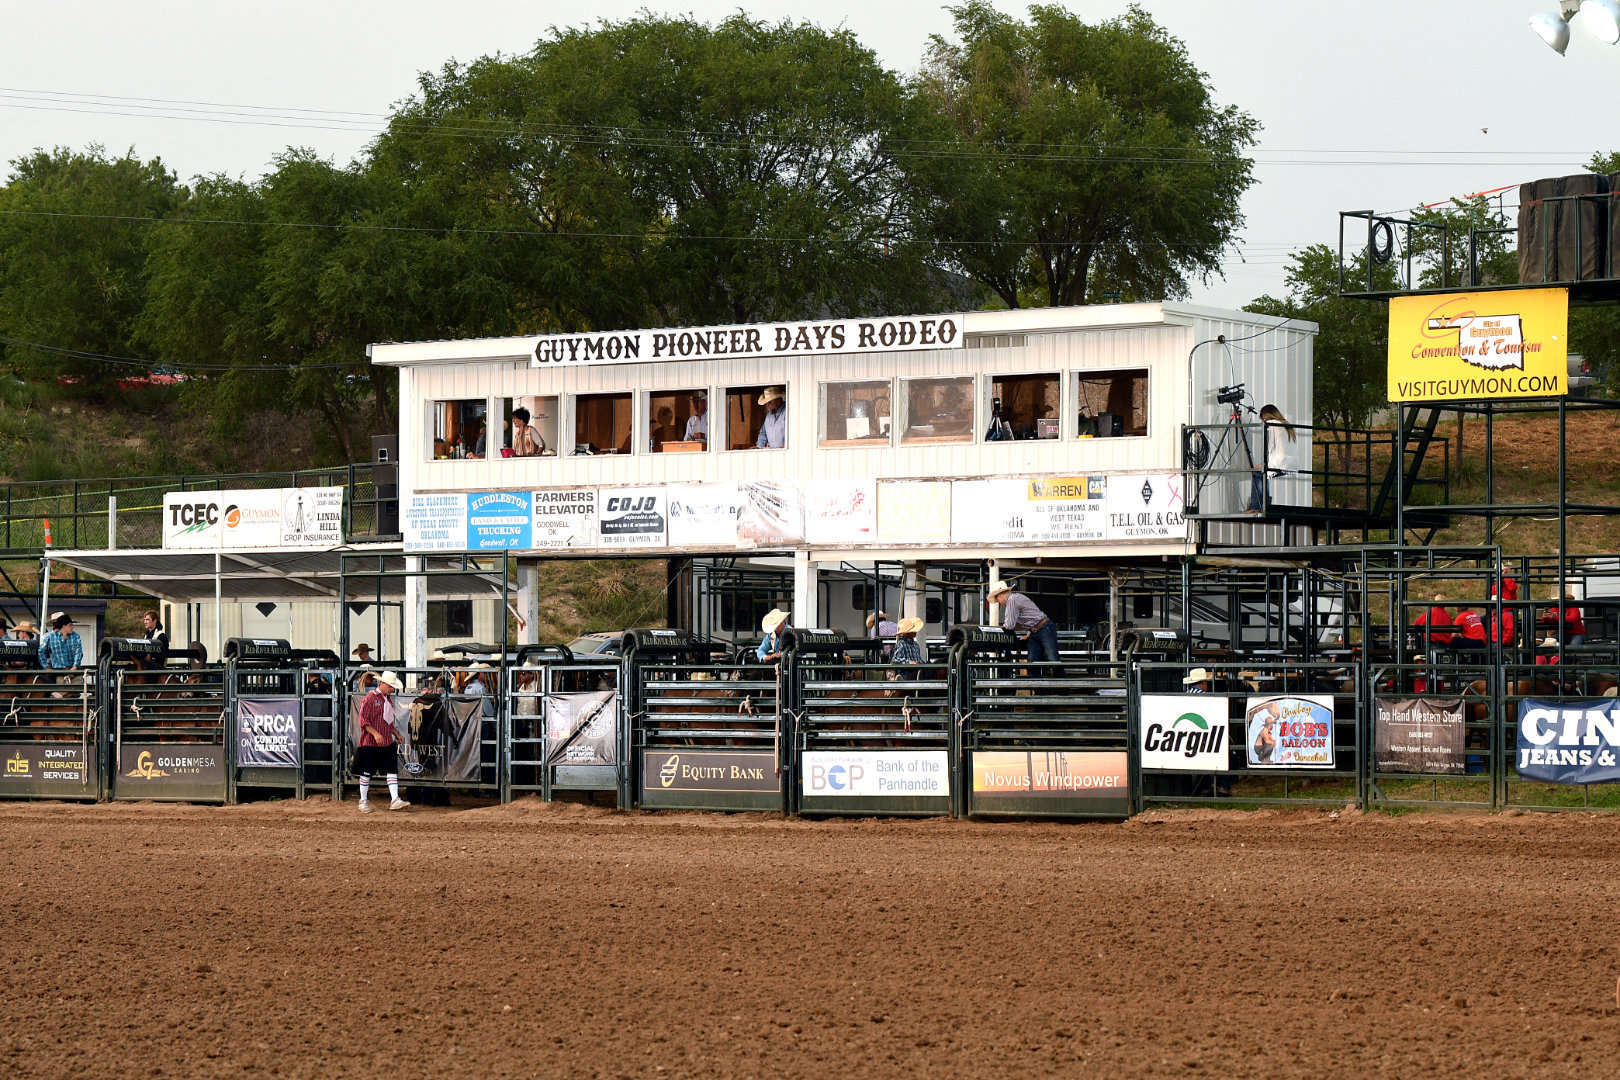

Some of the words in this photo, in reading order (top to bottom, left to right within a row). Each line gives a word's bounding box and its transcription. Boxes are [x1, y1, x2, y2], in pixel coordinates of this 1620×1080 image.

[1470, 326, 1512, 338] Guymon
[535, 334, 640, 363] GUYMON
[652, 328, 762, 357] PIONEER
[774, 324, 846, 351] DAYS
[858, 319, 957, 348] RODEO
[1411, 342, 1476, 359] Convention
[1478, 340, 1489, 356] &
[1494, 338, 1542, 354] Tourism
[1398, 376, 1558, 398] VISITGUYMON.COM
[1032, 481, 1082, 496] WARREN
[472, 494, 528, 510] HUDDLESTON
[536, 492, 594, 502] FARMERS
[606, 496, 656, 512] COJO
[170, 503, 218, 526] TCEC
[536, 504, 594, 514] ELEVATOR
[316, 512, 340, 521] LINDA
[1138, 512, 1152, 526] OIL
[1156, 512, 1163, 526] &
[1166, 512, 1185, 526] GAS
[320, 522, 338, 531] HILL
[478, 526, 520, 535] TRUCKING
[304, 533, 340, 542] INSURANCE
[1378, 708, 1390, 723] Top
[1392, 708, 1410, 722] Hand
[1412, 708, 1440, 722] Western
[1443, 710, 1462, 722] Store
[254, 714, 296, 732] PRCA
[1280, 722, 1328, 737] BOB'S
[254, 736, 288, 744] COWBOY
[1144, 723, 1225, 758] Cargill
[1282, 738, 1326, 748] SALOON
[44, 750, 76, 758] QUALITY
[1520, 748, 1592, 768] JEANS
[1598, 750, 1616, 766] &
[38, 761, 84, 769] INTEGRATED
[682, 764, 726, 780] EQUITY
[730, 766, 764, 780] BANK
[876, 760, 905, 772] Bank
[908, 760, 920, 772] of
[922, 760, 940, 772] the
[44, 772, 79, 780] SERVICES
[984, 772, 1030, 786] Novus
[1035, 771, 1120, 791] Windpower
[878, 778, 938, 790] Panhandle
